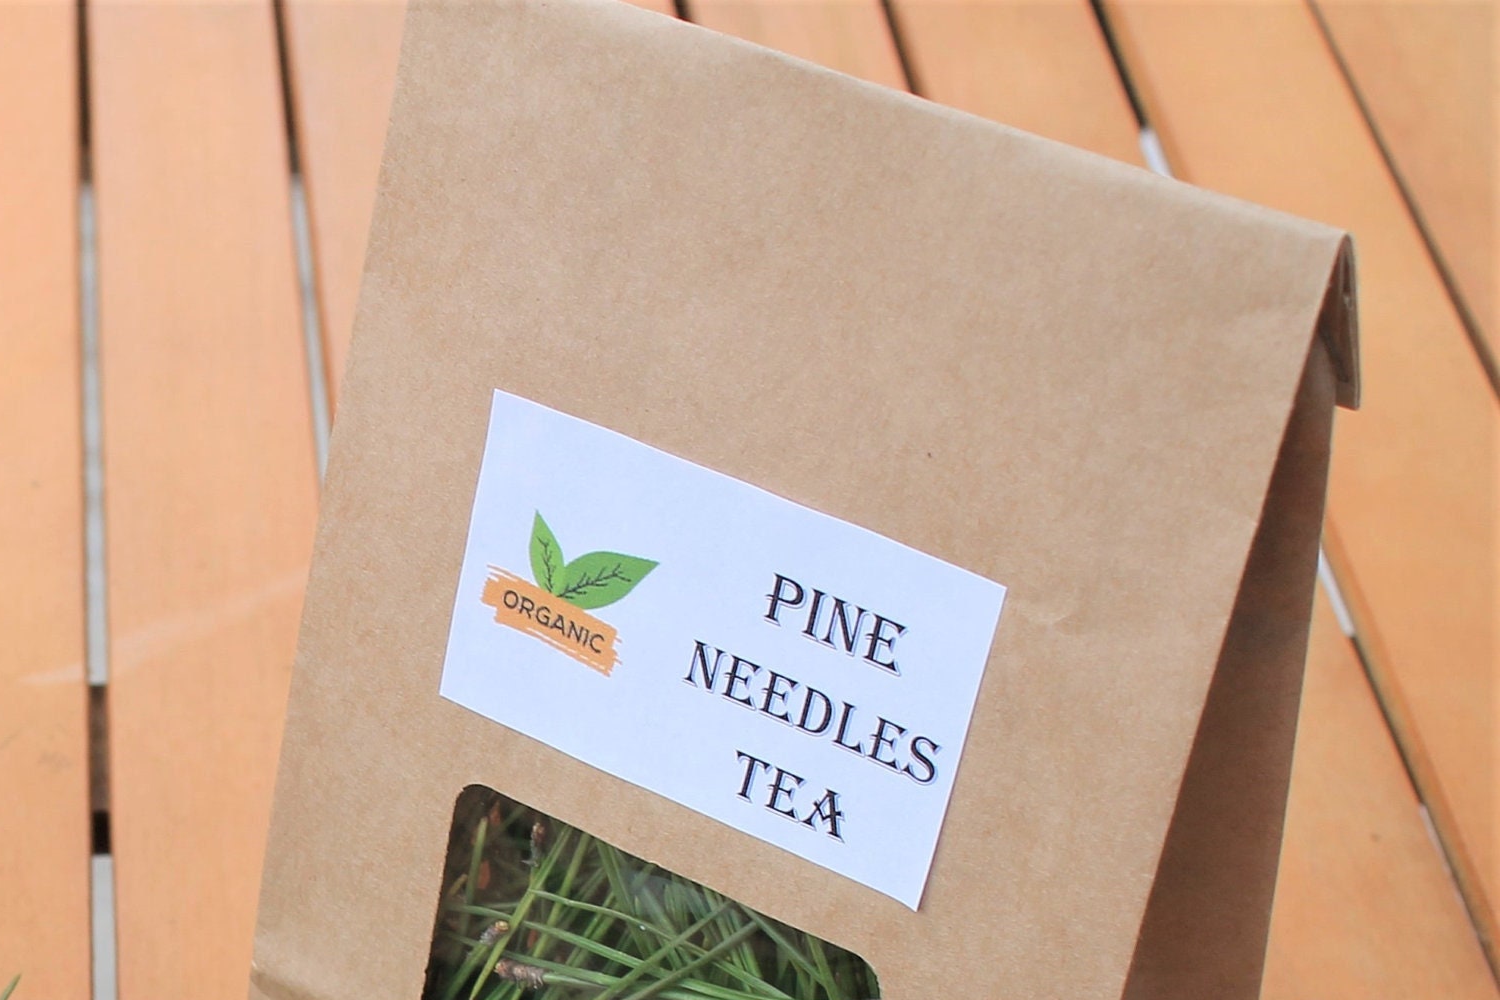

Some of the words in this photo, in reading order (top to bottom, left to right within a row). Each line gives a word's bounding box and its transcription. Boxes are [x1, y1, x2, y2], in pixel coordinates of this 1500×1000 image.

[503, 589, 606, 655] ORGANIC
[763, 573, 908, 676] PINE
[682, 639, 943, 786] NEEDLES
[735, 749, 846, 843] TEA
